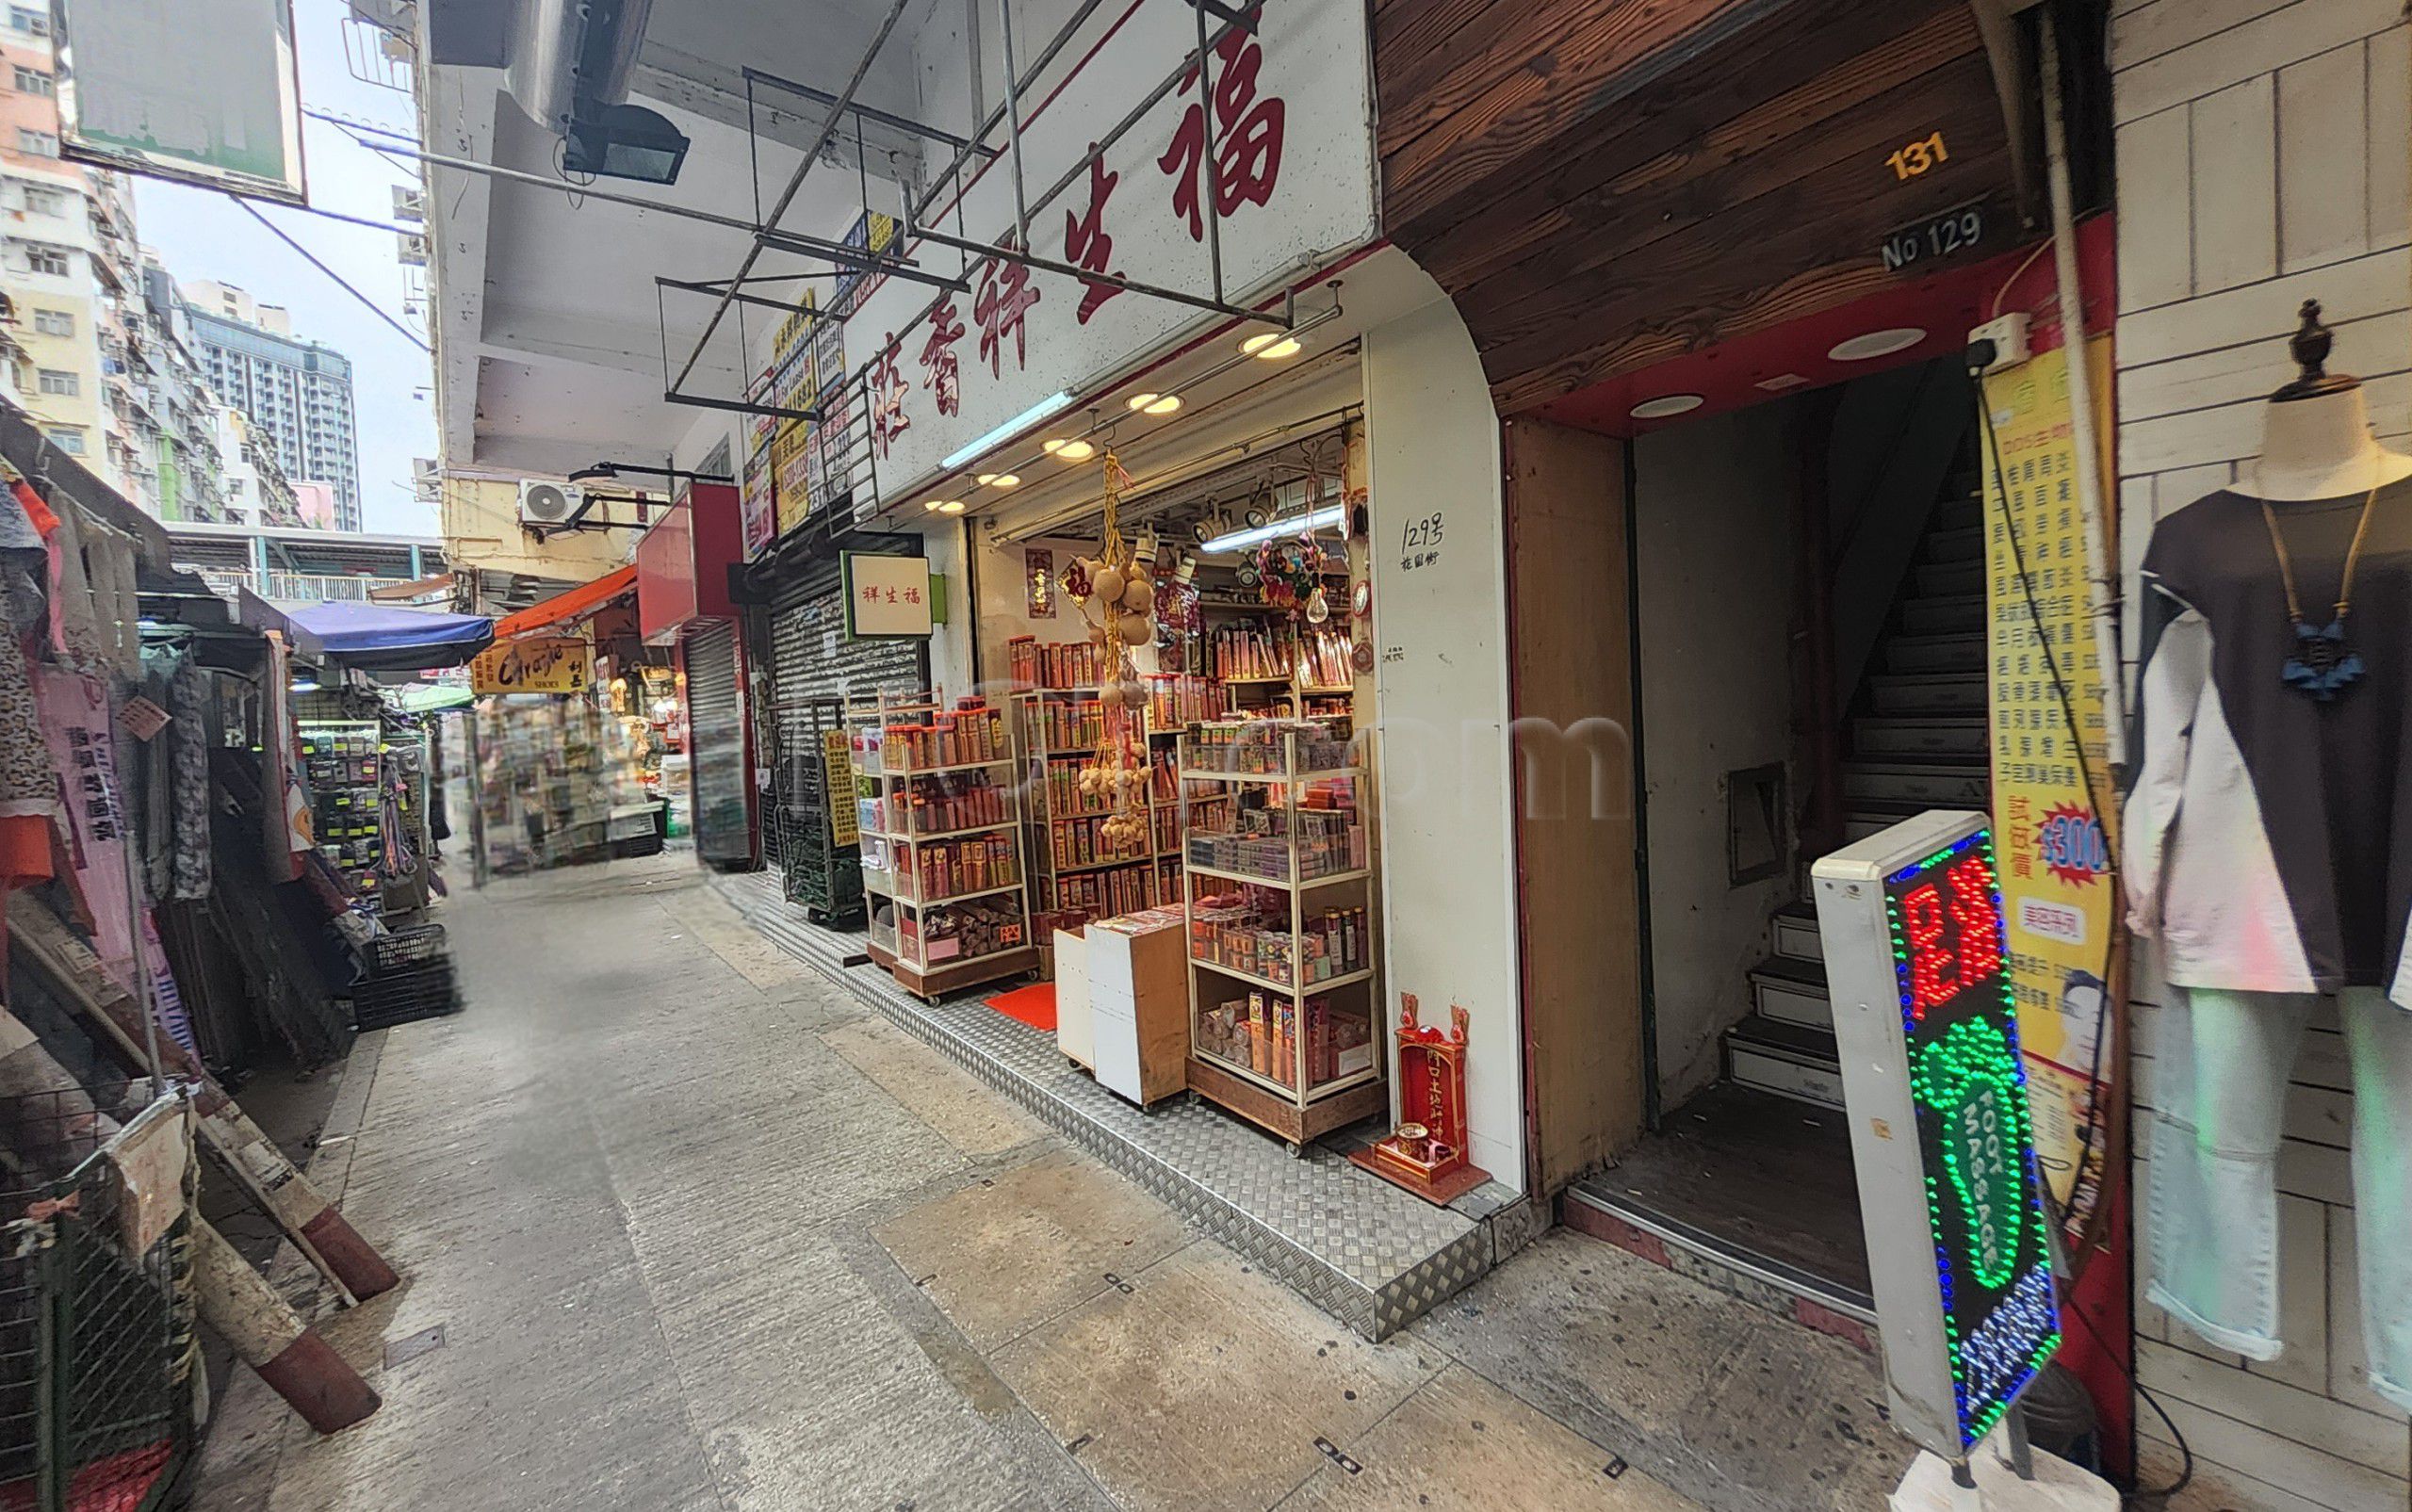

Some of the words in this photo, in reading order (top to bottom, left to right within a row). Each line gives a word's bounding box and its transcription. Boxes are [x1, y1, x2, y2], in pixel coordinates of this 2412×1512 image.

[1884, 131, 1949, 180] 131
[1882, 236, 1918, 272] No
[1928, 212, 1981, 256] 129
[1979, 1089, 2004, 1176] FOOT
[1963, 1102, 1999, 1272] MASSAGE
